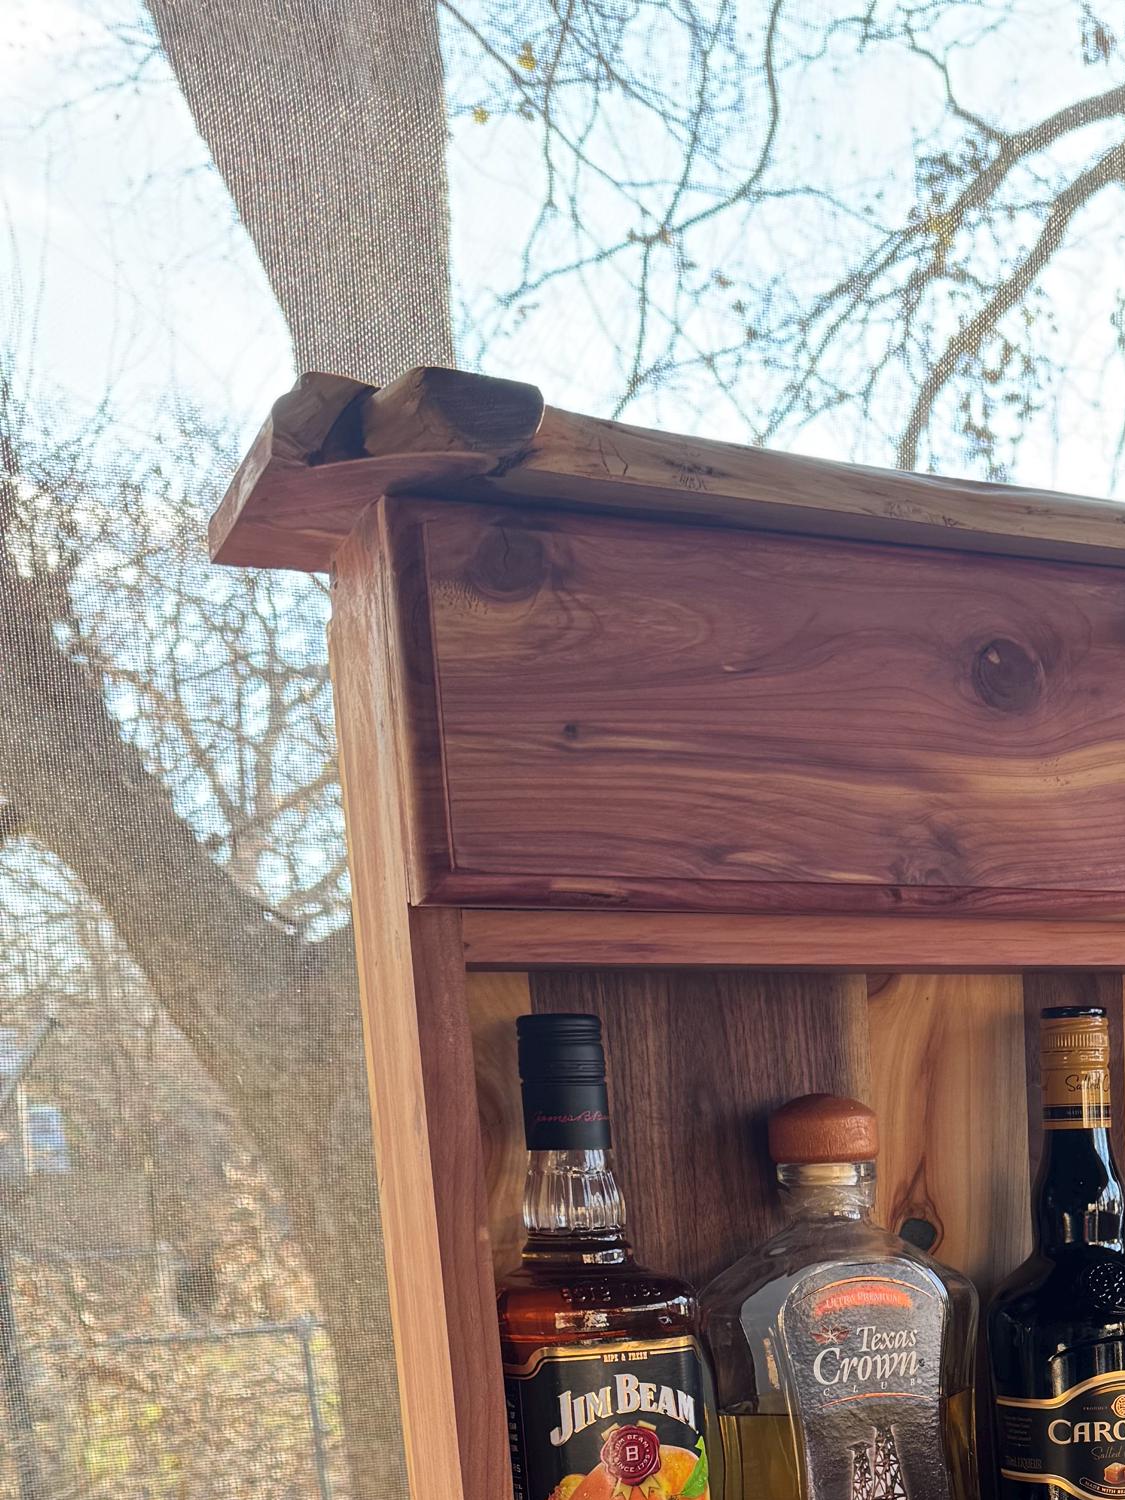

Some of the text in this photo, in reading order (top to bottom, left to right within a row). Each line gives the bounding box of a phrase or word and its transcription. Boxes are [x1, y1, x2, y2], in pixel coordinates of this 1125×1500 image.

[857, 1326, 918, 1352] Texas
[604, 1351, 648, 1363] RIPE & FRESH
[813, 1347, 920, 1385] Crown
[550, 1373, 697, 1447] JIM BEAM
[626, 1434, 649, 1448] BEAM
[626, 1445, 639, 1461] B
